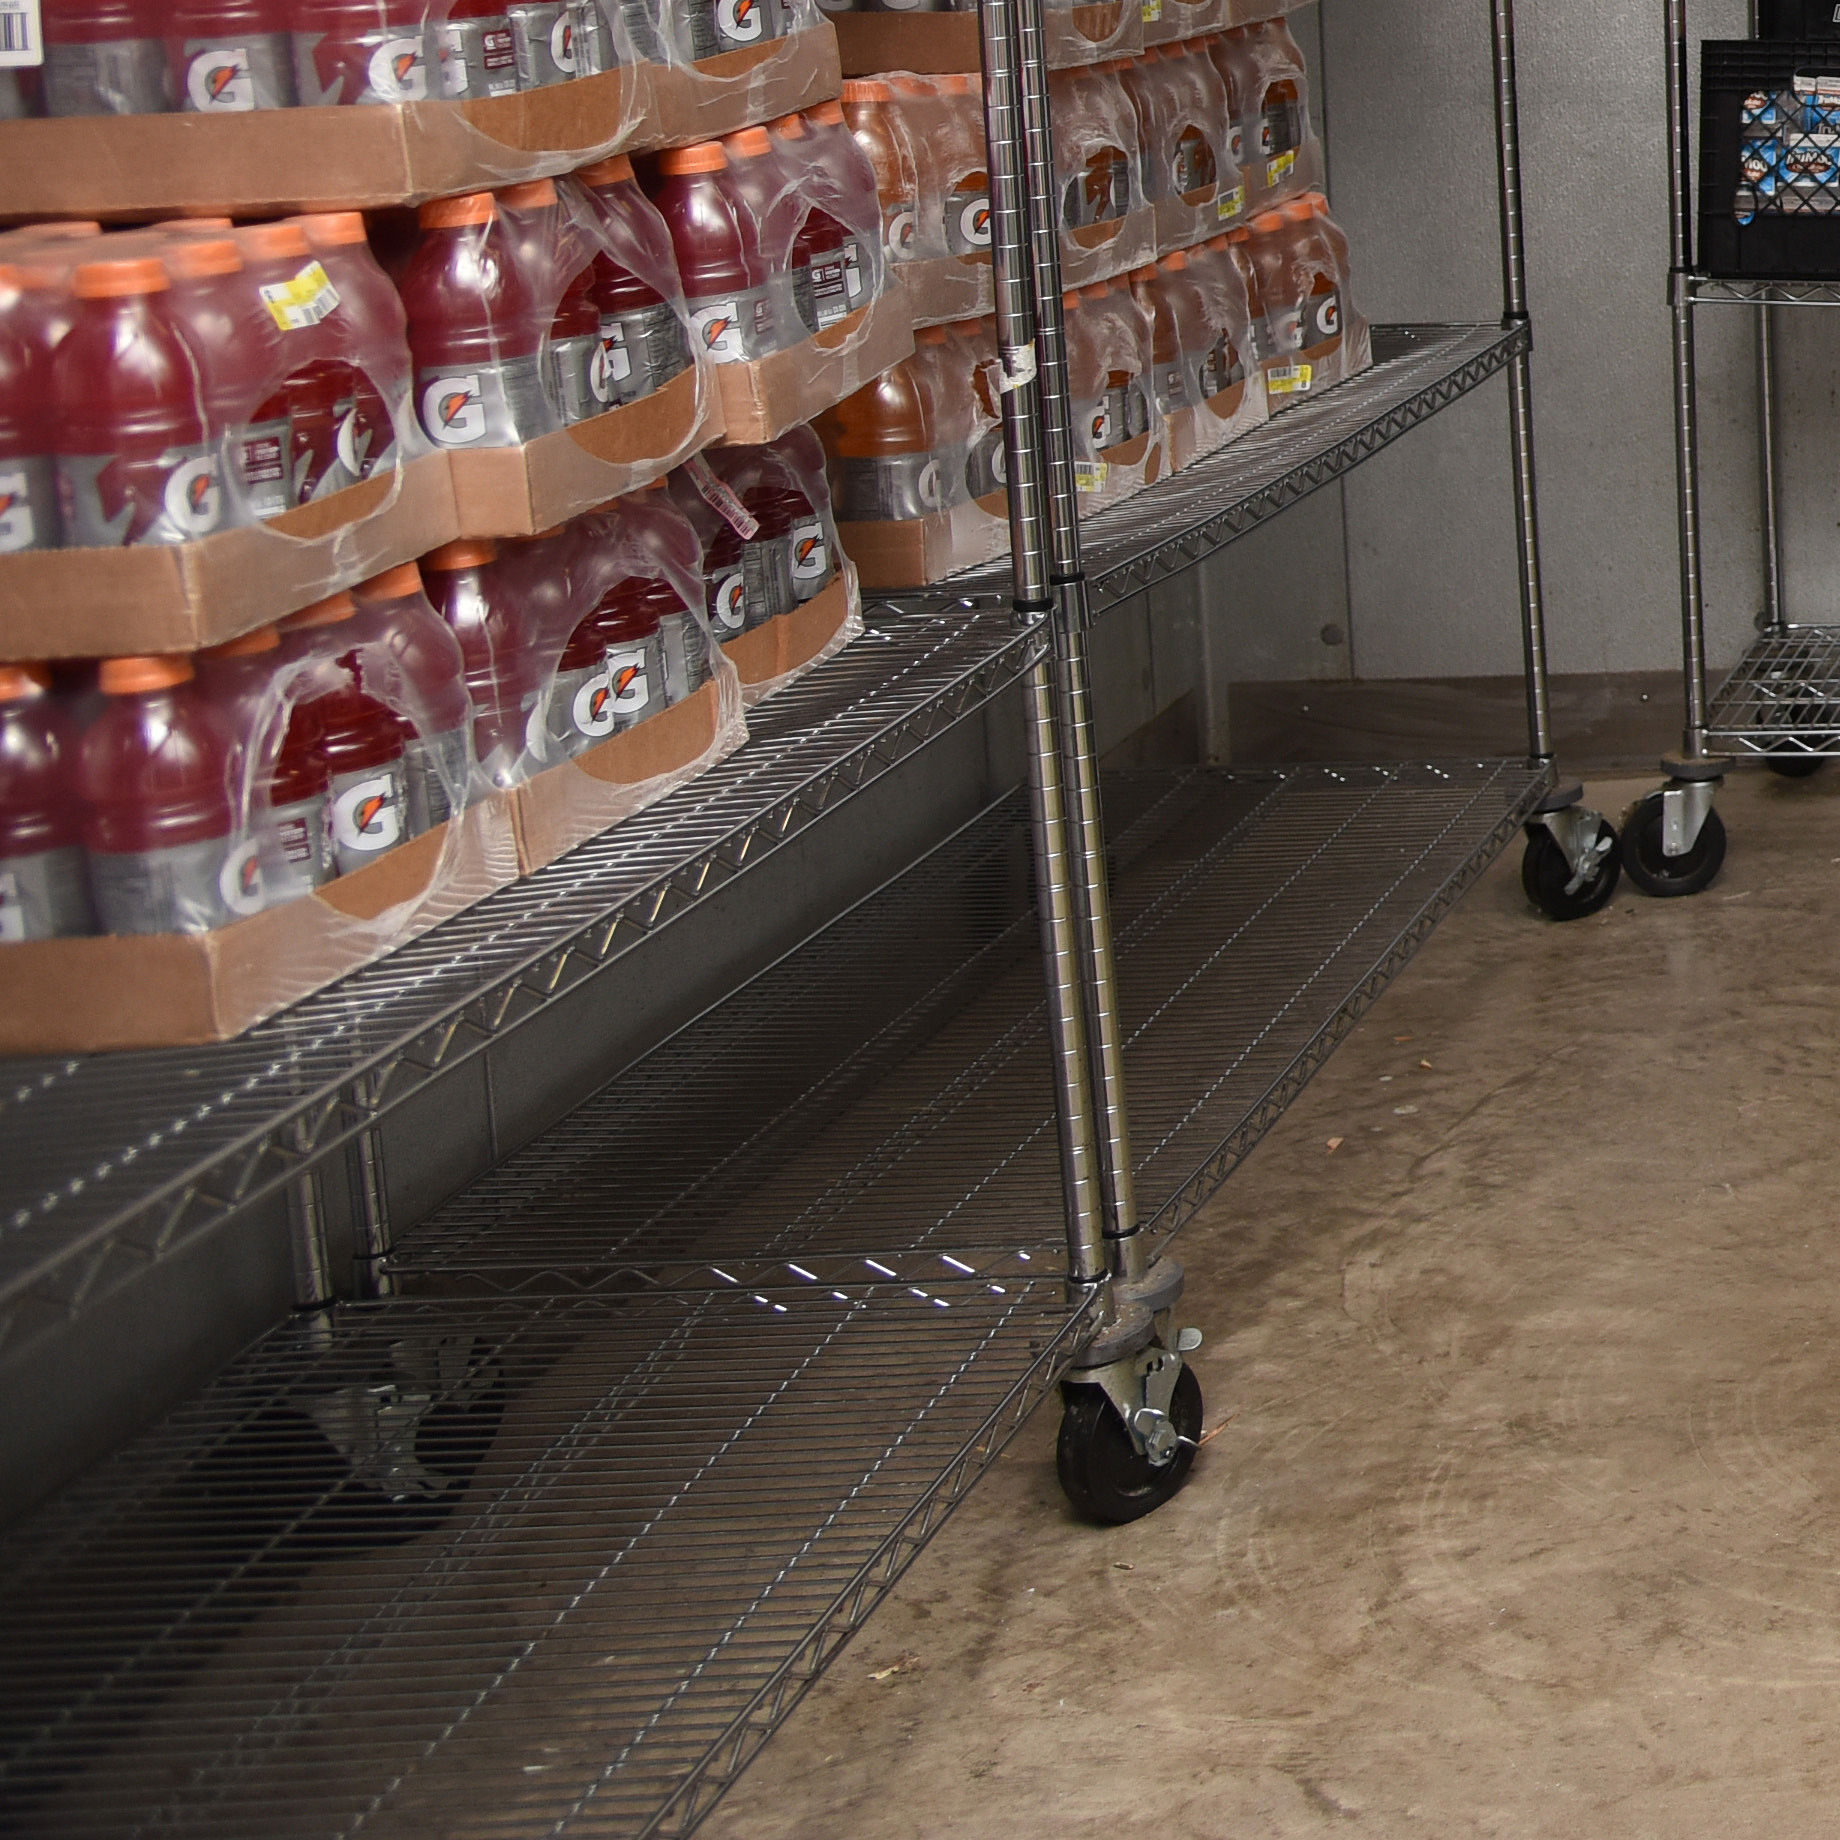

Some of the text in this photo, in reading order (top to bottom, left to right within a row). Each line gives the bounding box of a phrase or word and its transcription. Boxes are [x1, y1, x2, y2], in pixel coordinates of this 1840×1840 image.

[187, 48, 256, 113] G
[691, 301, 745, 364] G
[422, 374, 487, 444] G
[792, 521, 828, 580] G
[605, 647, 649, 715] G
[333, 772, 403, 852] G
